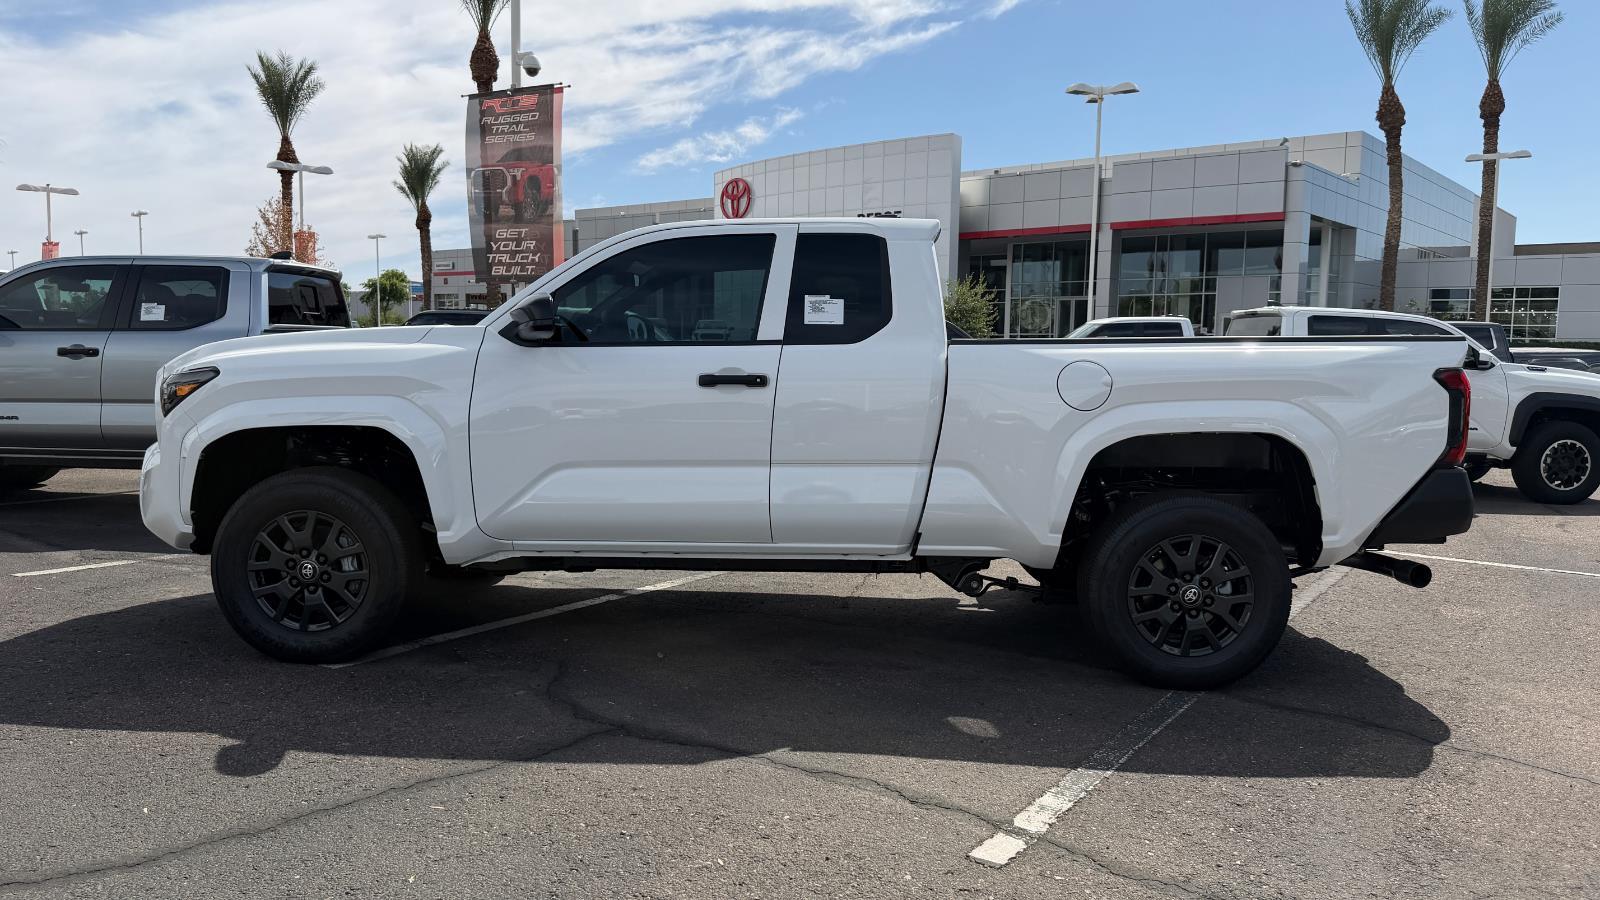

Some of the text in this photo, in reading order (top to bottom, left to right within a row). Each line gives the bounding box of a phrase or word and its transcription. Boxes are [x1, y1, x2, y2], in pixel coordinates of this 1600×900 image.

[481, 112, 539, 124] RUGGED
[491, 124, 530, 133] TRAIL
[484, 132, 537, 144] SERIES
[495, 228, 529, 239] GET
[490, 240, 536, 251] YOUR
[486, 252, 541, 263] TRUCK
[491, 265, 536, 276] BUILT.
